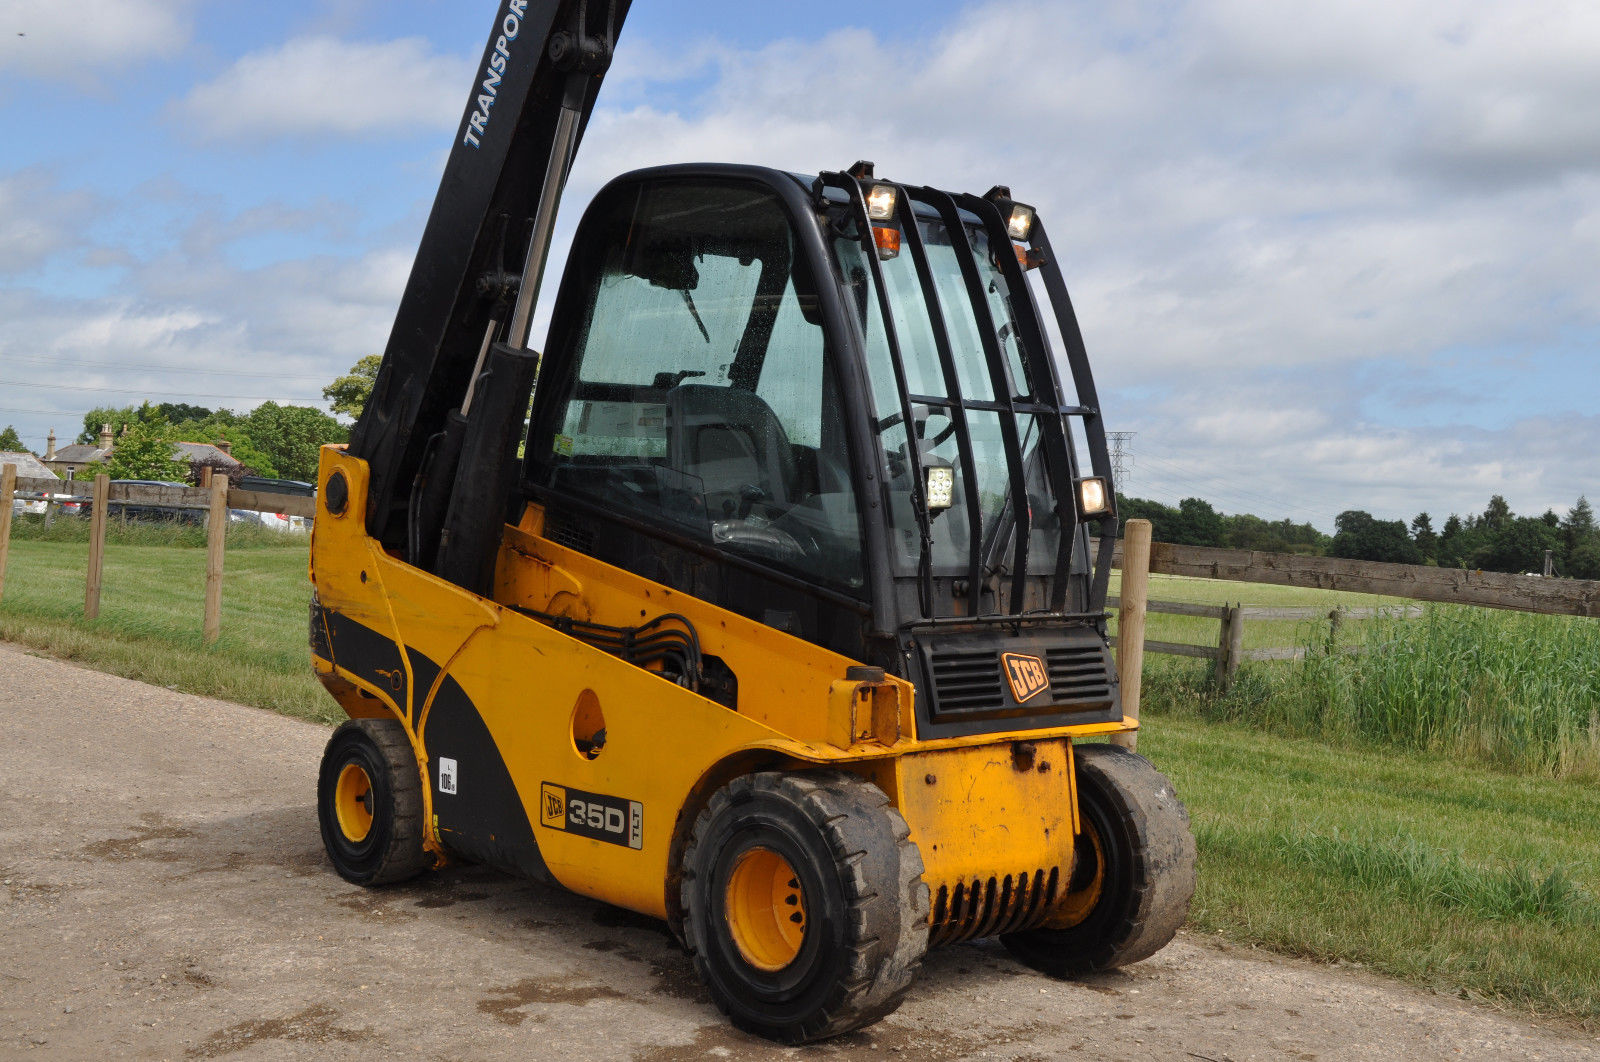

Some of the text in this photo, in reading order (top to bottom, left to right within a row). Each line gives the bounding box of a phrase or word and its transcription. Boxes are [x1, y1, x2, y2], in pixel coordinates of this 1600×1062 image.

[1010, 659, 1044, 697] JCB
[547, 795, 625, 834] JCB 35D
[632, 809, 640, 841] TLT
